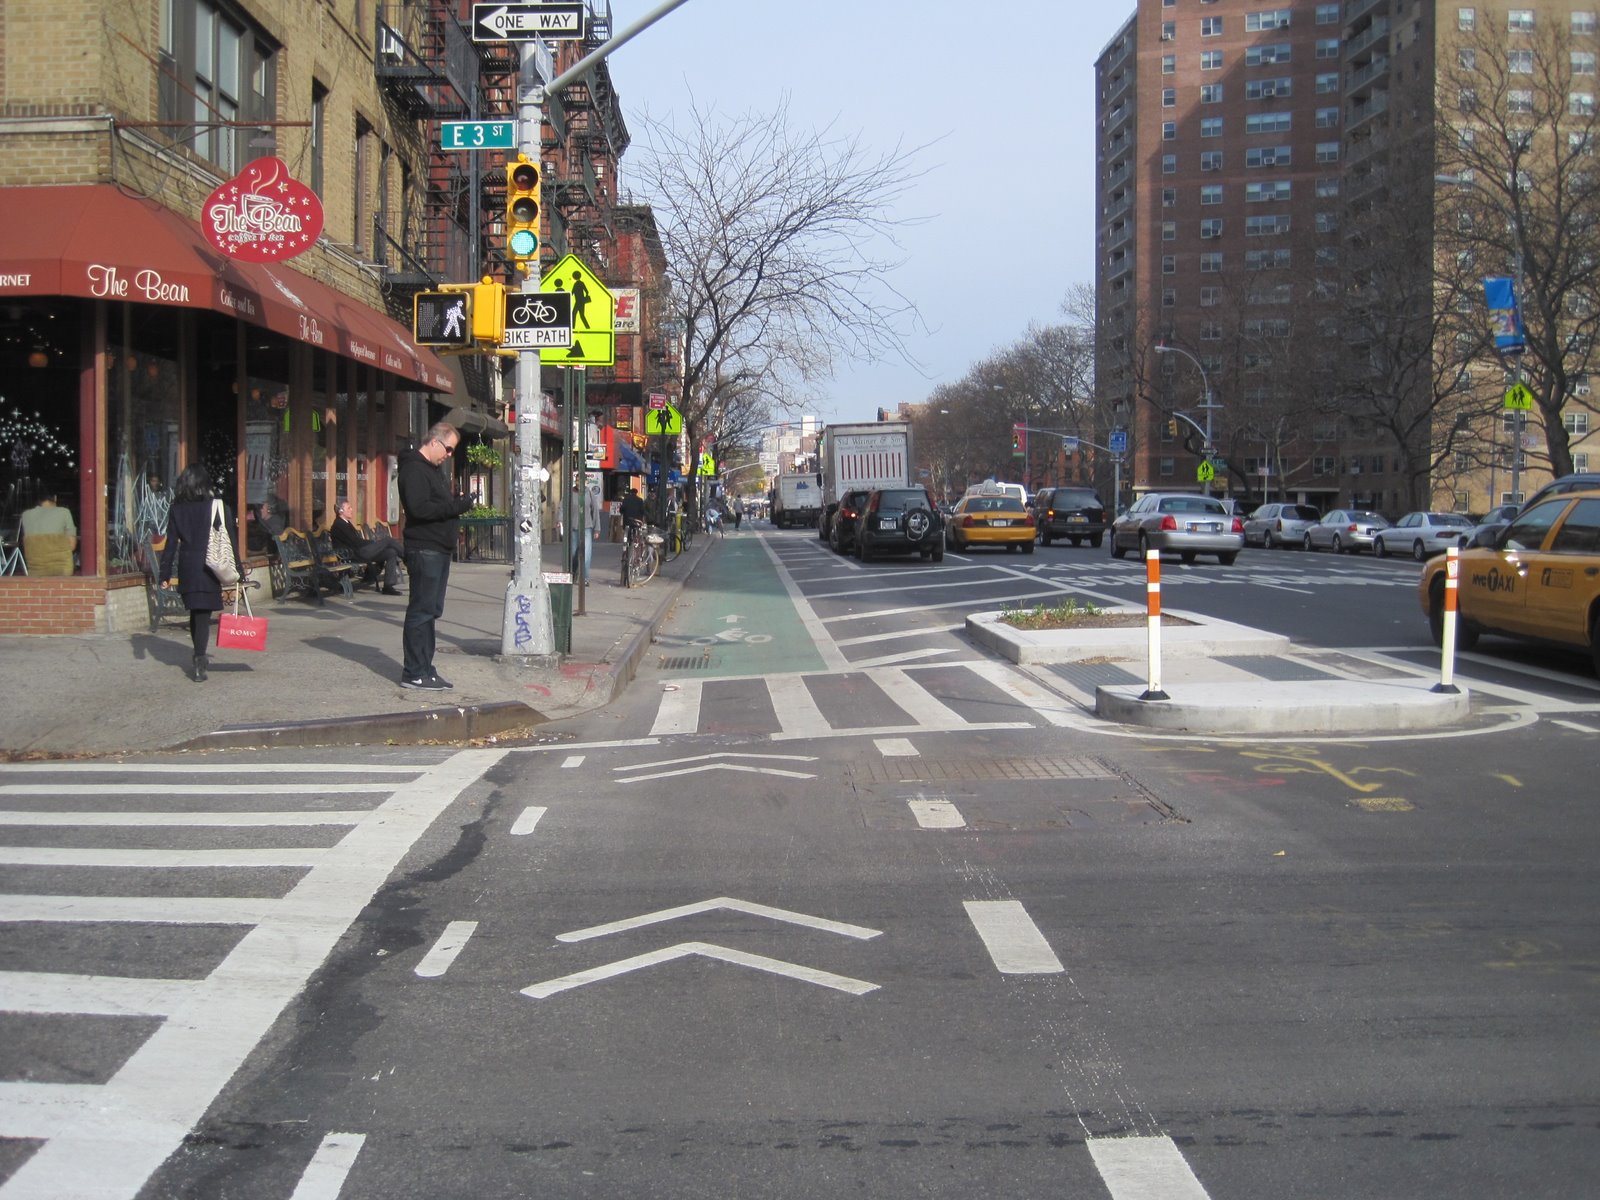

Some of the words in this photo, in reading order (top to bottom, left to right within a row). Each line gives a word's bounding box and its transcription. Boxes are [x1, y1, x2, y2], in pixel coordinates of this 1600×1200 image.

[495, 15, 524, 28] ONE
[540, 14, 572, 27] WAY
[453, 126, 464, 146] E
[473, 126, 484, 145] 3
[492, 125, 504, 136] ST
[210, 204, 247, 234] The
[251, 204, 302, 232] Bean
[0, 274, 31, 286] RNET
[87, 264, 128, 297] The
[135, 269, 189, 302] Bean
[614, 296, 636, 318] E
[504, 331, 530, 344] BIKE
[536, 329, 566, 343] PATH
[230, 629, 256, 638] ROMO
